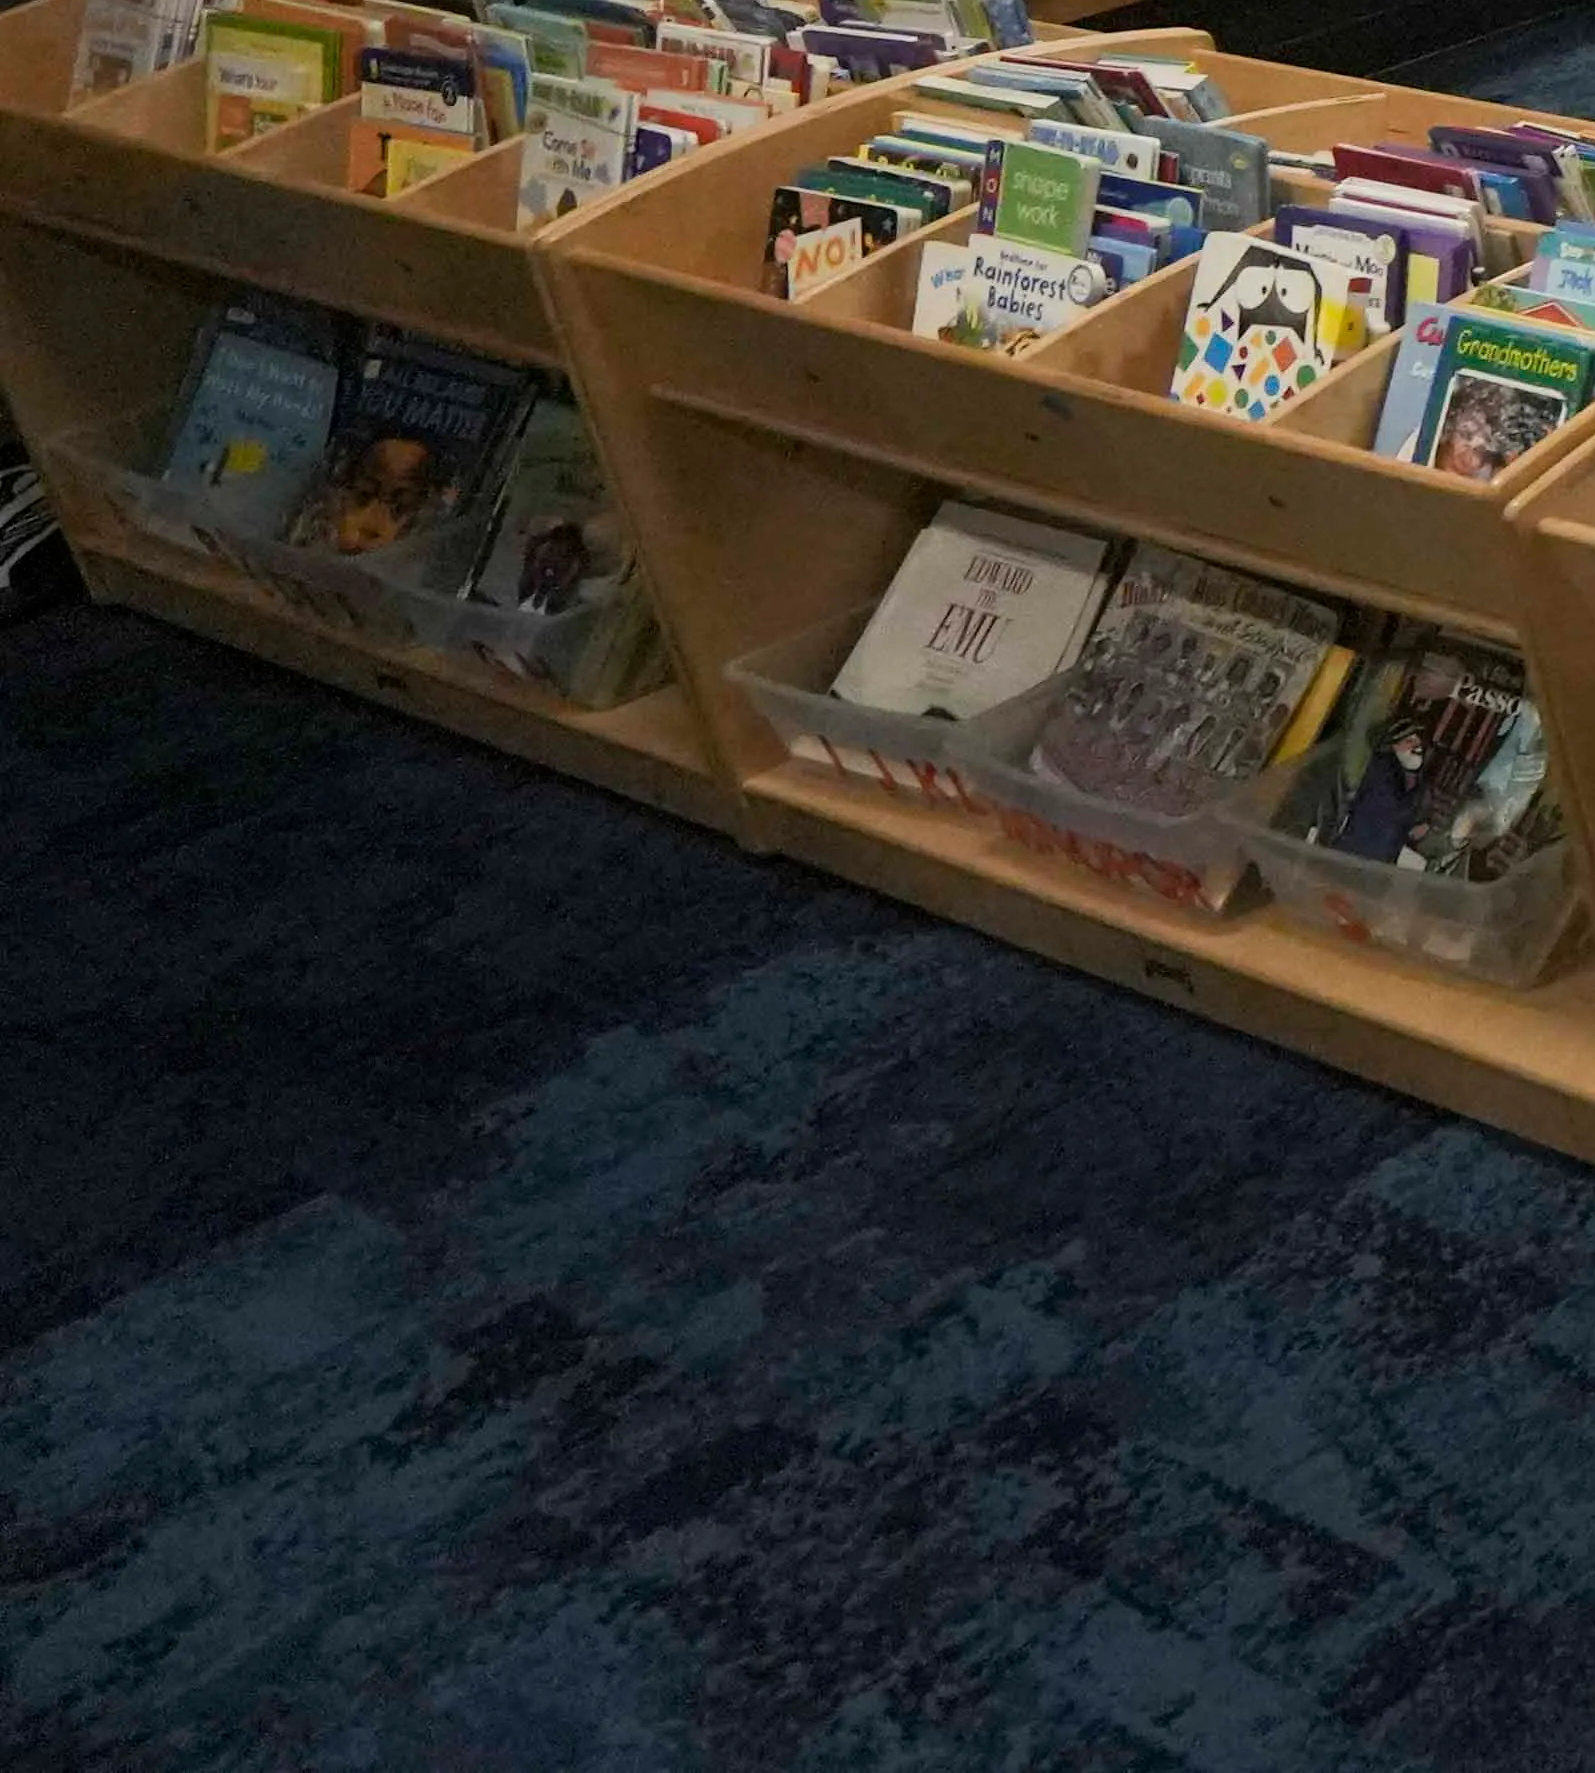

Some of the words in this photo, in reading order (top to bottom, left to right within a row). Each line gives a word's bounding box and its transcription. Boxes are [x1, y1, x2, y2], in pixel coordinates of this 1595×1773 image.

[1012, 169, 1070, 202] shape
[1016, 201, 1058, 229] work
[795, 228, 857, 279] NO!
[973, 257, 1066, 302] Rainforest
[988, 286, 1044, 322] Babies
[1456, 329, 1578, 382] Grandmothers
[964, 555, 1034, 595] EDWARD
[922, 602, 1015, 664] EMU
